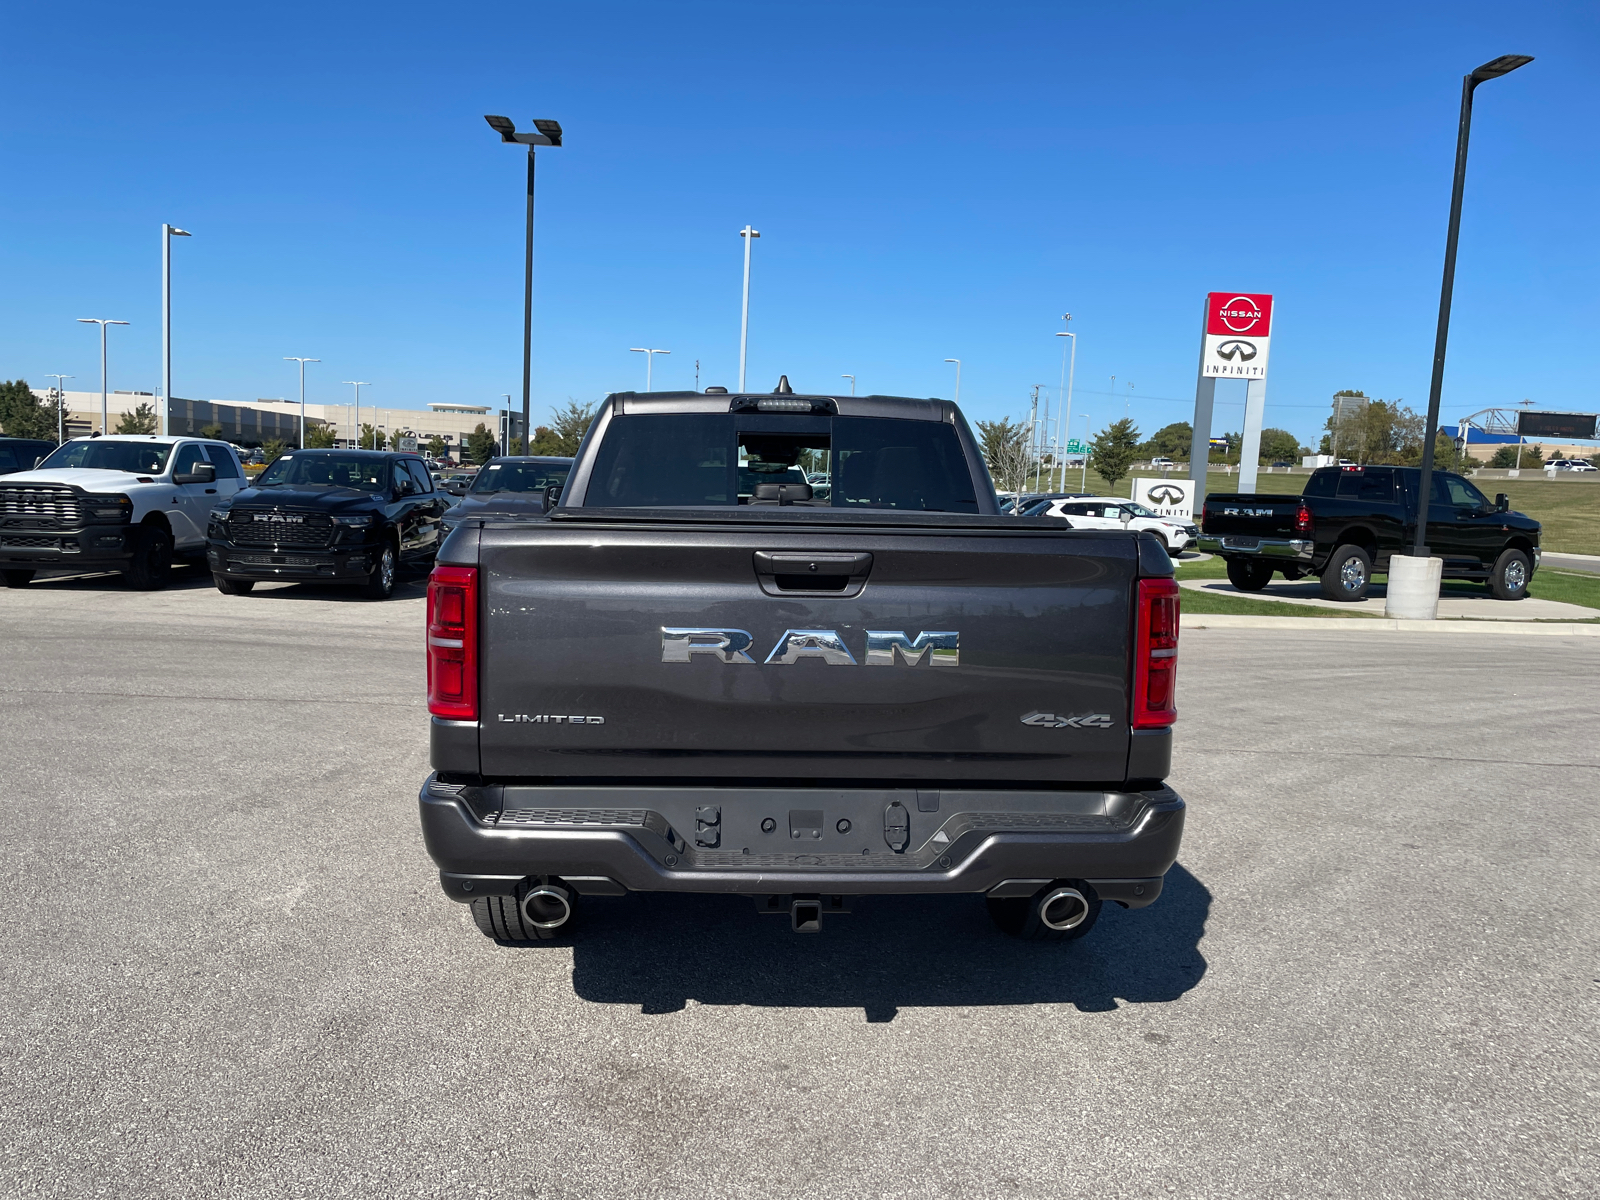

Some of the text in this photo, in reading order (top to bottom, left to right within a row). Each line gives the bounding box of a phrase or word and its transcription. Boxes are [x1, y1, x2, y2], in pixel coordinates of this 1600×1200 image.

[1219, 309, 1261, 318] NISSAN
[1206, 365, 1264, 375] INFINITI
[1149, 508, 1189, 516] FINITI
[1223, 507, 1273, 517] RAM
[253, 514, 304, 523] RAM
[661, 626, 960, 667] RAM
[498, 714, 605, 724] LIMITED
[1021, 713, 1115, 728] 4x4
